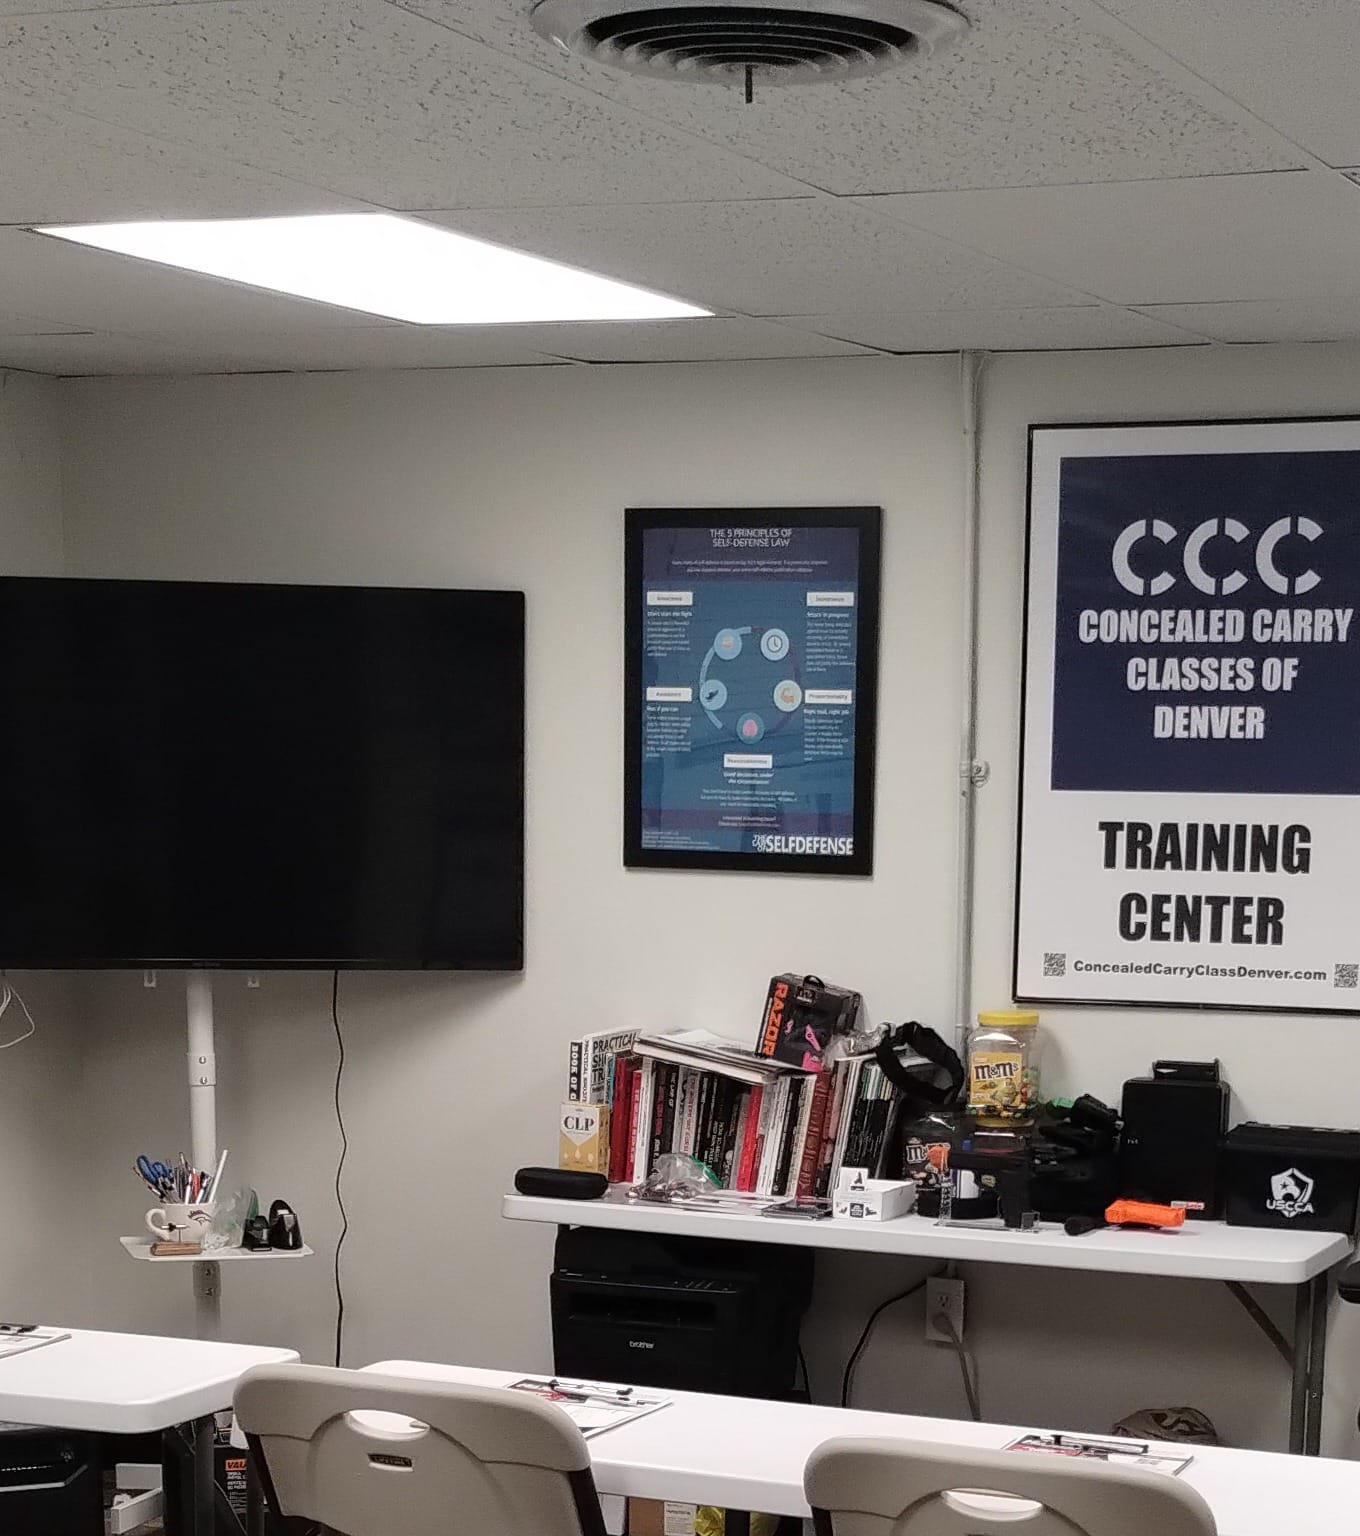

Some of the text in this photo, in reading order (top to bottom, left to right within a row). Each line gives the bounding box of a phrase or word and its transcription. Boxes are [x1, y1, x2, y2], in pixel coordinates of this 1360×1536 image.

[710, 529, 725, 538] THE
[734, 529, 780, 538] PRINCIPLES
[781, 529, 792, 537] OF
[1112, 516, 1324, 596] CCC
[1079, 608, 1353, 643] CONCEALED CARRY
[1126, 657, 1299, 691] CLASSES OF
[1154, 706, 1265, 739] DENVER
[766, 836, 853, 855] SELFDEFENSE
[1098, 821, 1311, 874] TRAINING
[1119, 892, 1284, 945] CENTER
[1074, 960, 1327, 980] ConcealedCarryClassDenver.com
[762, 982, 788, 1056] RAZOR
[564, 1116, 594, 1131] CLP
[1266, 1199, 1314, 1214] USCCA
[629, 1341, 654, 1349] brother
